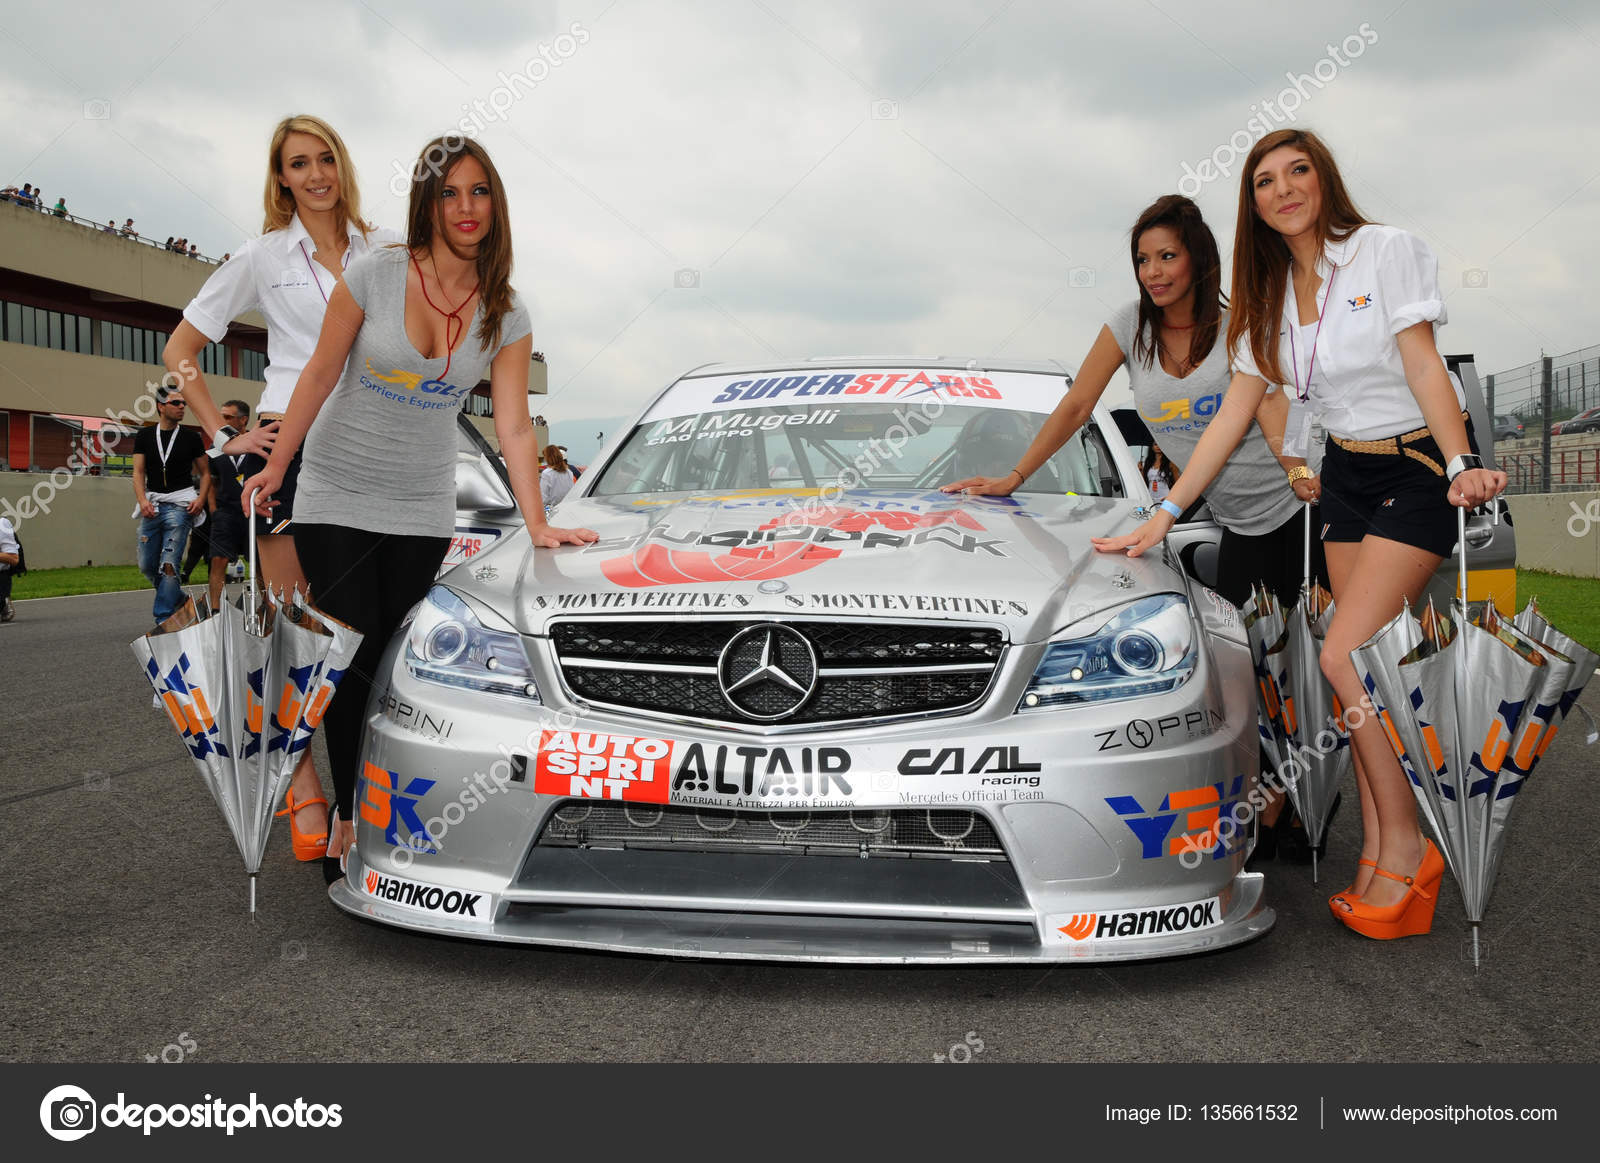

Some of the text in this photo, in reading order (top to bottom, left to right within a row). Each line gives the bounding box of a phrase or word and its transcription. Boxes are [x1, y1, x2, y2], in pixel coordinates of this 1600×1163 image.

[360, 375, 406, 403] Corriere
[712, 371, 1003, 403] SUPERSTARS
[703, 409, 841, 430] Mugelli
[646, 429, 753, 446] CIAO PIPPO
[553, 592, 731, 609] MONTEVERTINE
[811, 593, 1007, 616] MONTEVERTINE
[543, 731, 669, 760] AUTO
[546, 751, 656, 782] SPRI
[672, 742, 853, 797] ALTAIR
[897, 746, 1042, 776] CAAL
[570, 775, 630, 800] NT
[981, 774, 1041, 787] racing
[899, 788, 1045, 803] Mercedes Official Team
